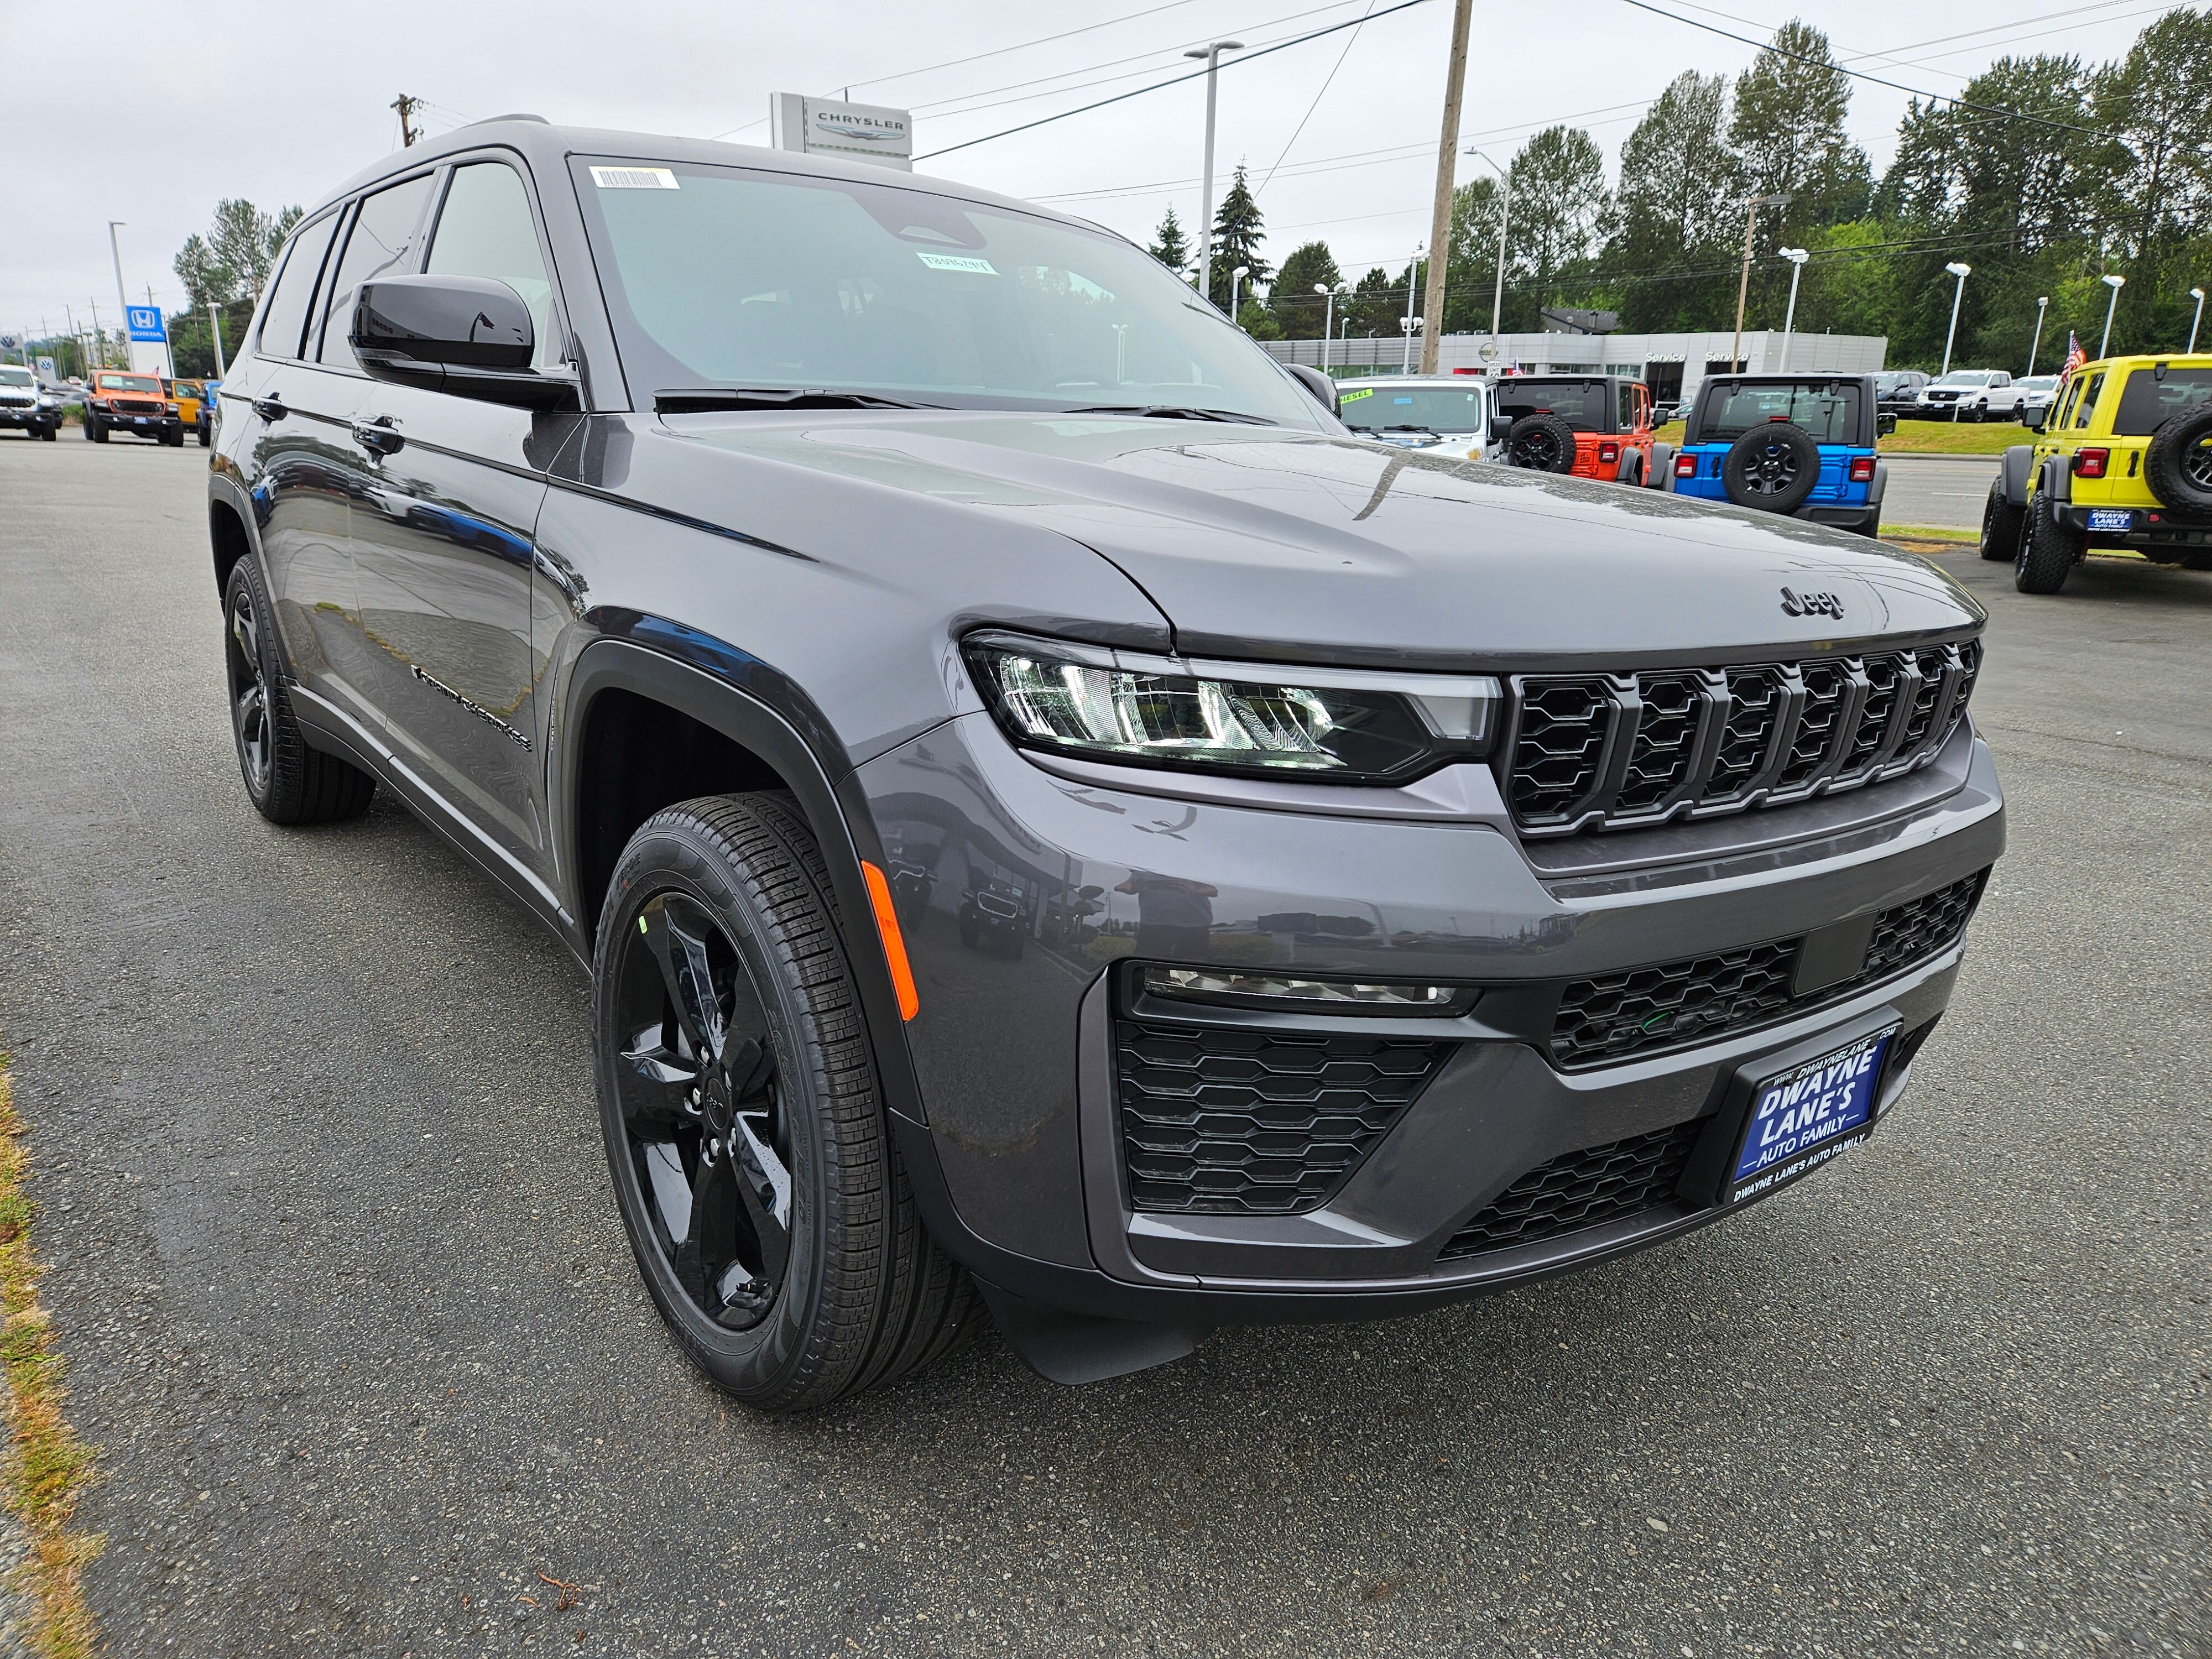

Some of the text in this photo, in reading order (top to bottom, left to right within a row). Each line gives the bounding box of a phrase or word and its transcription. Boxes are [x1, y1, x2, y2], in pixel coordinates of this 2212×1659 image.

[818, 112, 904, 130] CHRYSLER
[1645, 352, 1687, 363] Service
[1781, 586, 1845, 620] Jeep
[1758, 1046, 1877, 1120] DWAYNE
[1796, 1039, 1871, 1080] DWAYNELANE
[1760, 1081, 1856, 1147] LANE'S
[1756, 1114, 1846, 1168] AUTO FAMILY
[1733, 1133, 1866, 1202] DWAYNE LANE'S AUTO FAMILY
